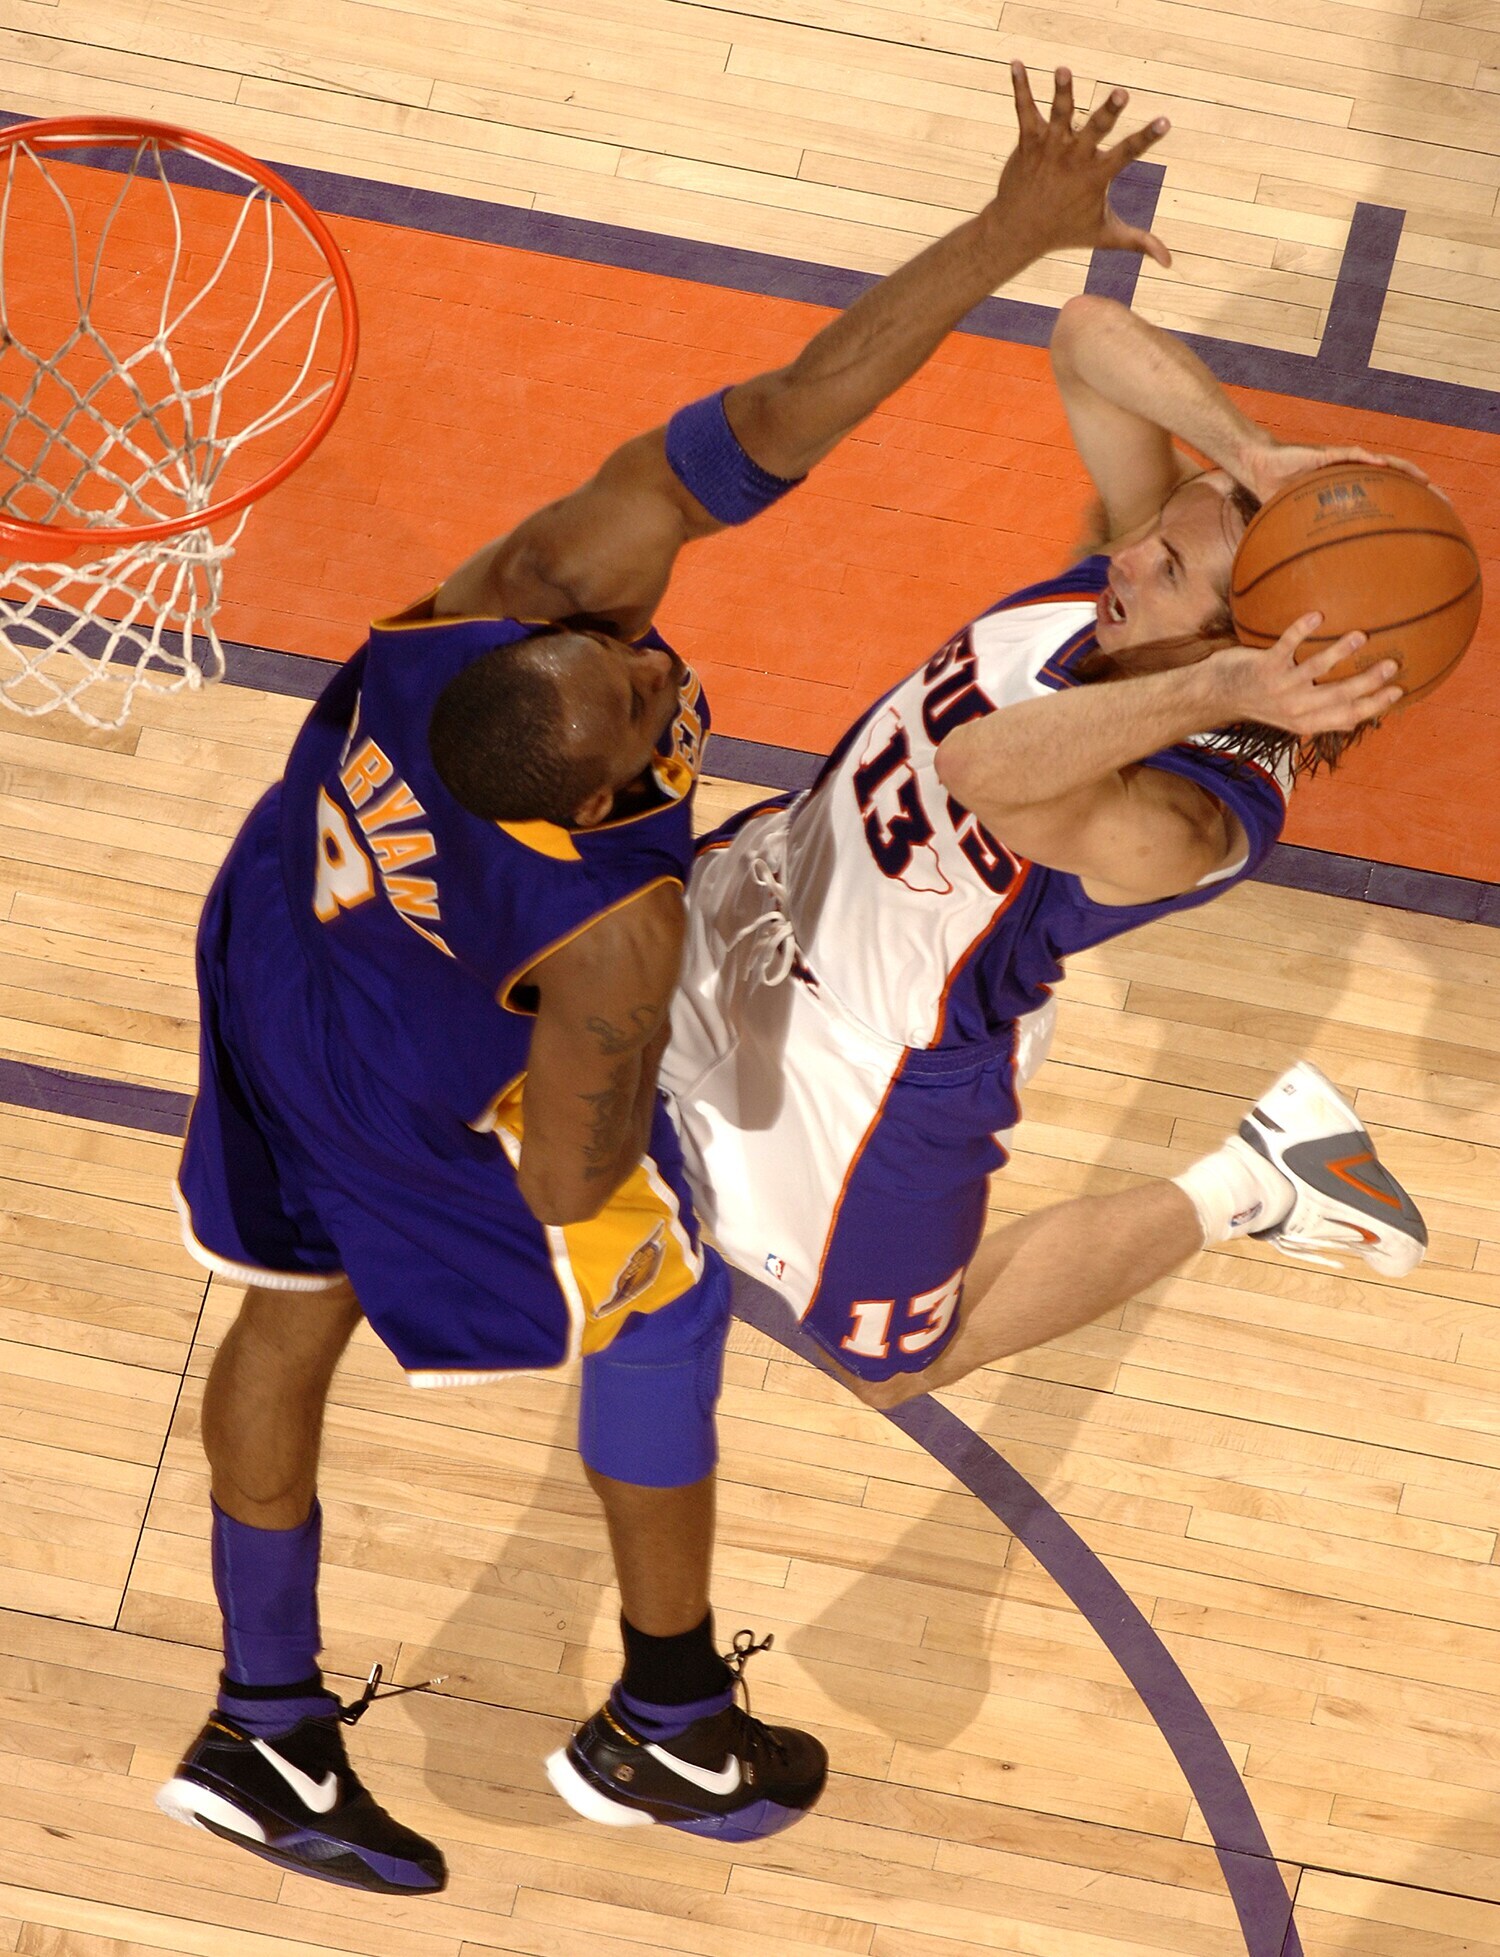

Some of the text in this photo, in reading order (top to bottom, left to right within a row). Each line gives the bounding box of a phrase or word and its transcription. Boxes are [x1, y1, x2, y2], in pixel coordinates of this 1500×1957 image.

[338, 690, 457, 960] RYAN
[853, 724, 936, 880] 13
[922, 622, 1022, 894] SUS
[841, 1265, 966, 1359] 13
